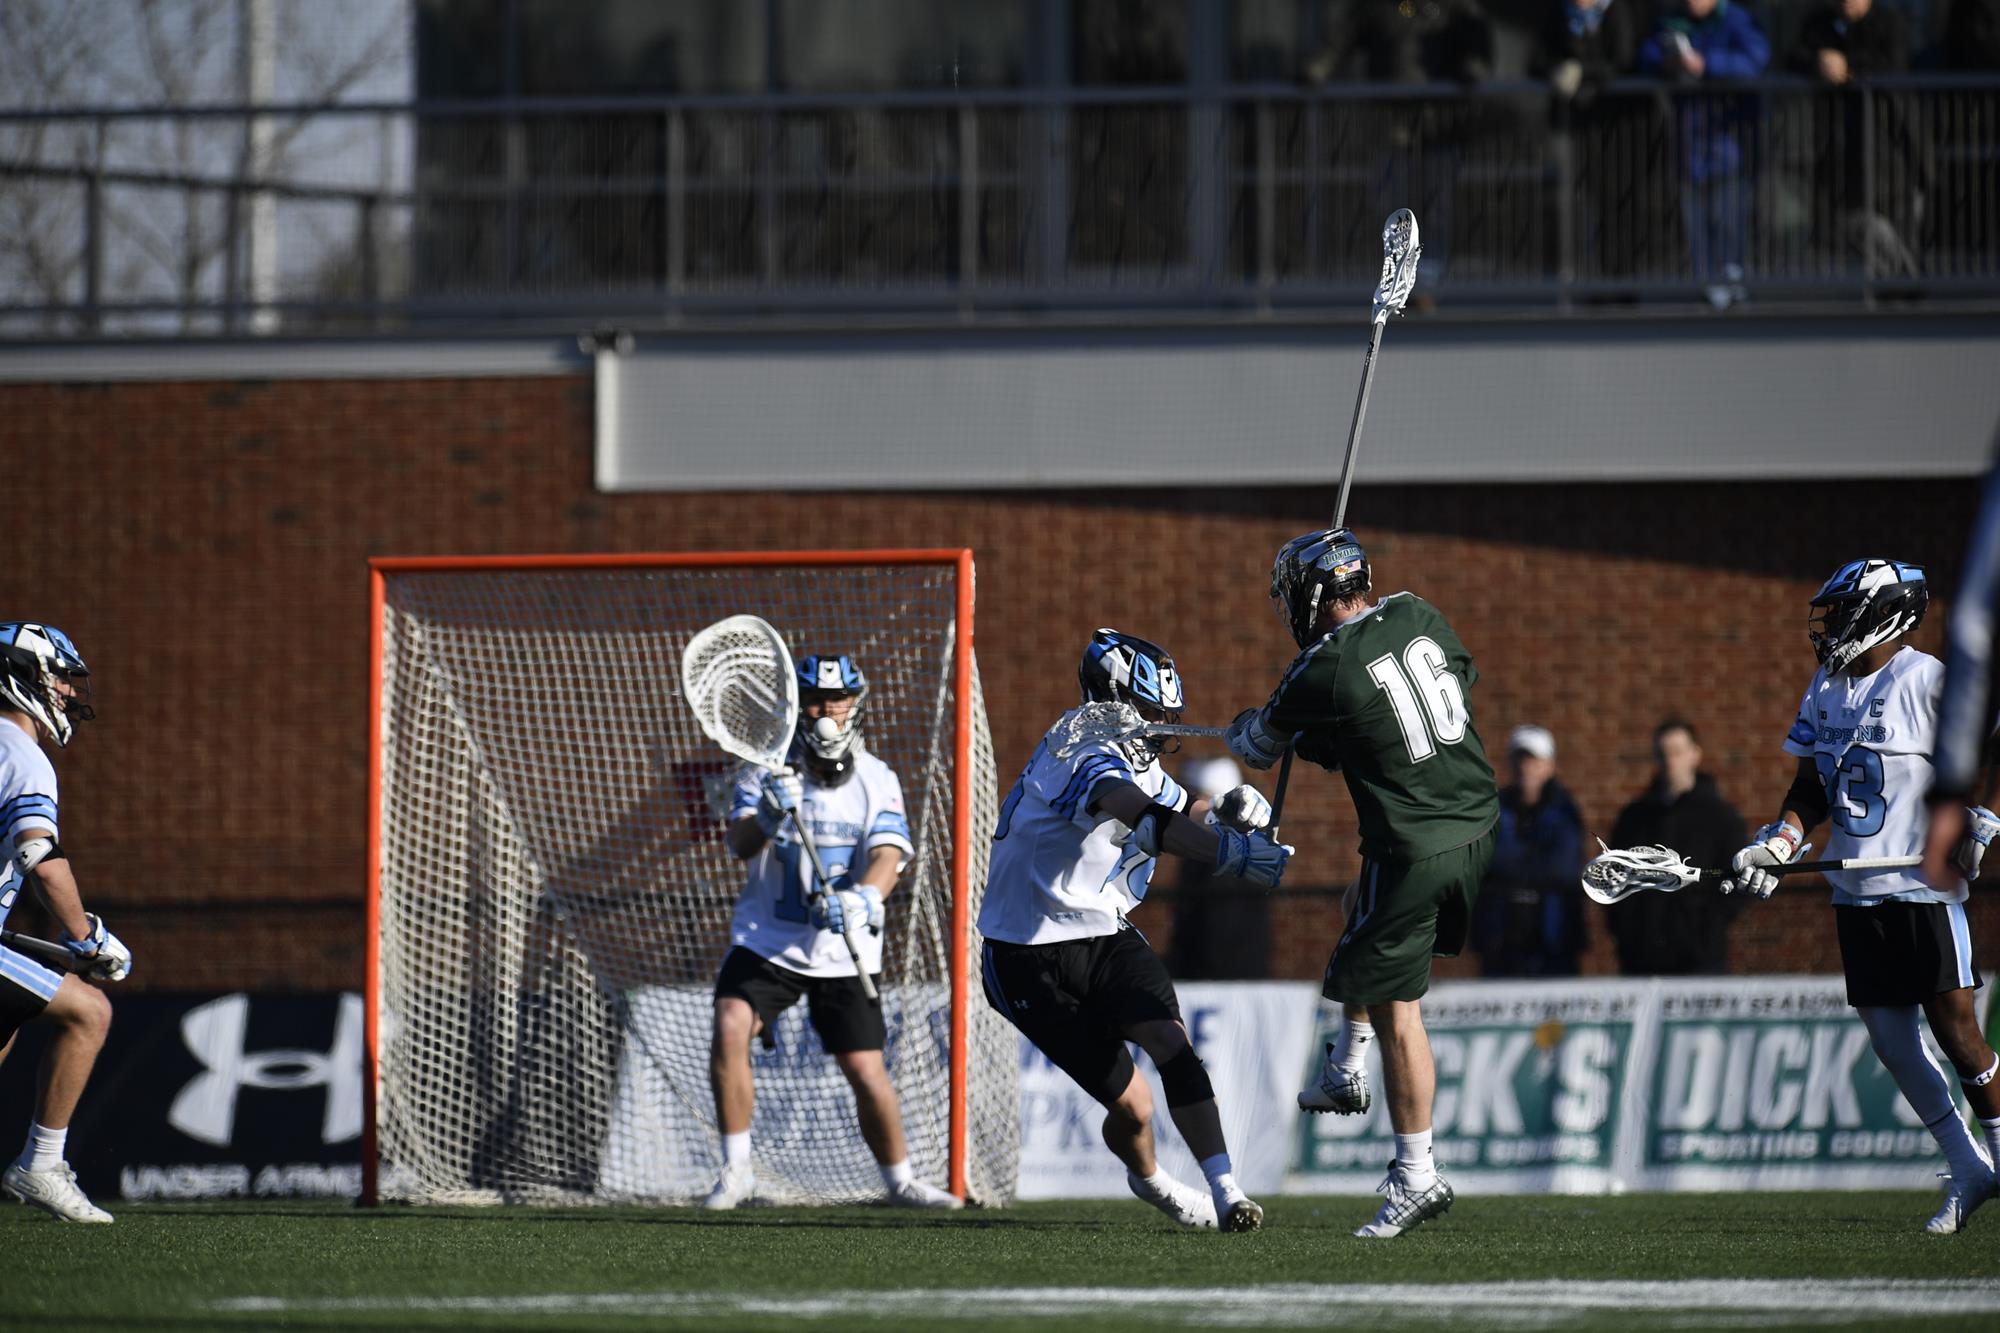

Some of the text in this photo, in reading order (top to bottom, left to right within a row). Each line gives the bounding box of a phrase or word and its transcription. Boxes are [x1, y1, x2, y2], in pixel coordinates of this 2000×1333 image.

[1365, 635, 1470, 765] 16
[1868, 698, 1886, 718] C
[1818, 724, 1887, 745] OPKNS
[1659, 1132, 1819, 1160] SPORTING
